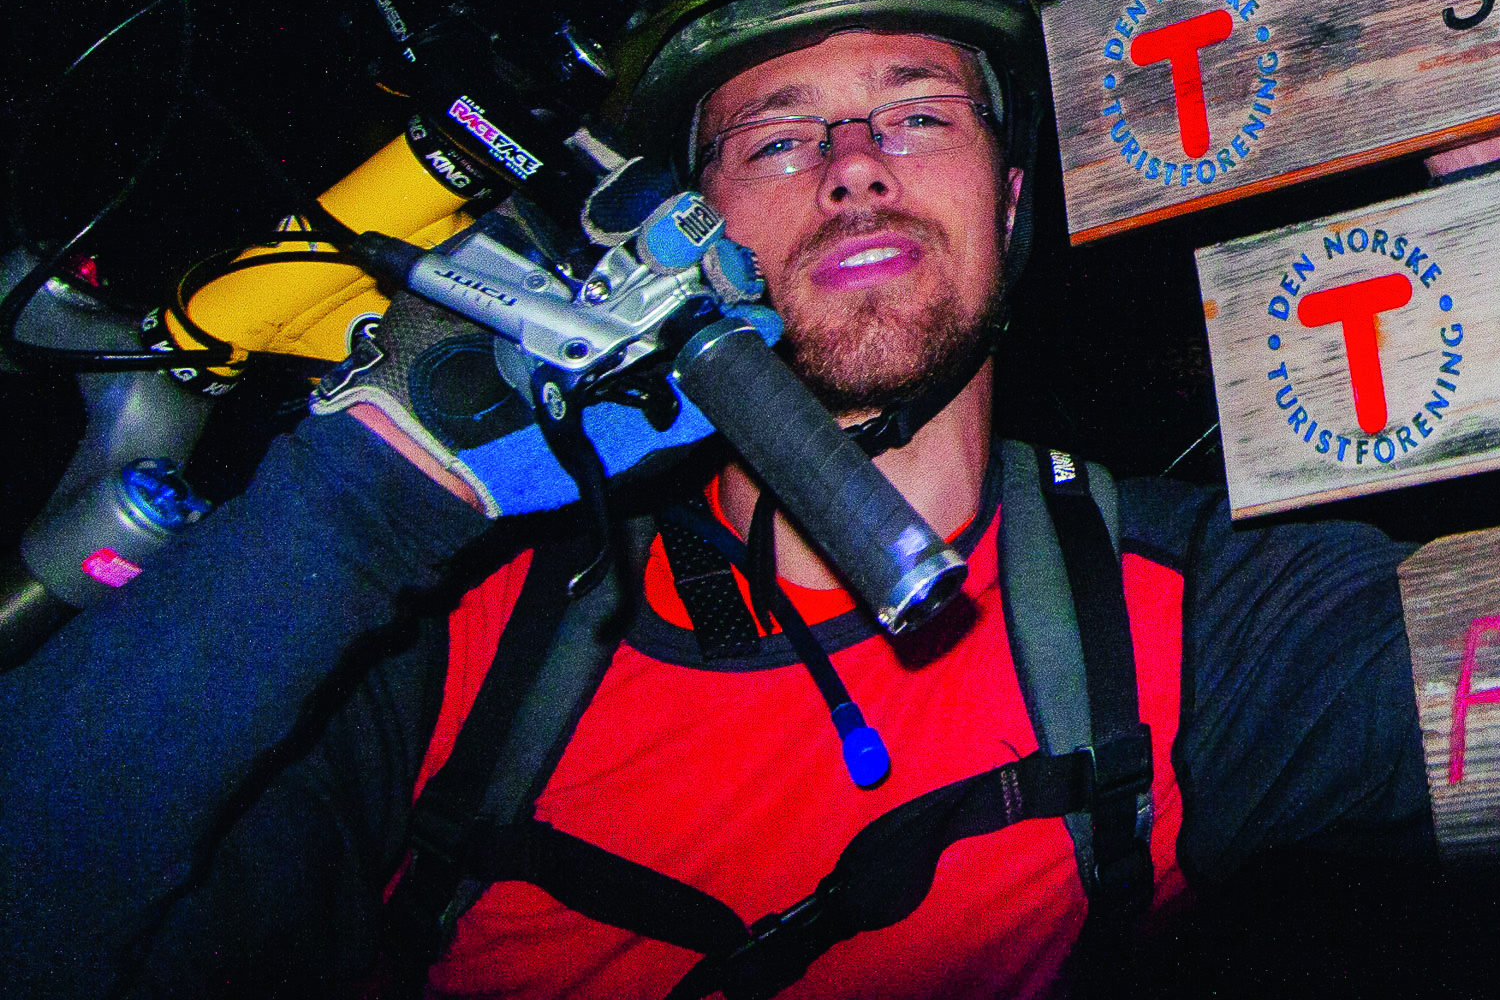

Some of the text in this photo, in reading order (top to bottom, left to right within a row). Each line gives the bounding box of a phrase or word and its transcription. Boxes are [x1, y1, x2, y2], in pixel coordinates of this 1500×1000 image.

[425, 150, 471, 188] KING
[1103, 50, 1279, 187] TURISTFORENING
[1268, 228, 1442, 321] DEN NORSKE
[1267, 323, 1463, 464] TURISTFORENING
